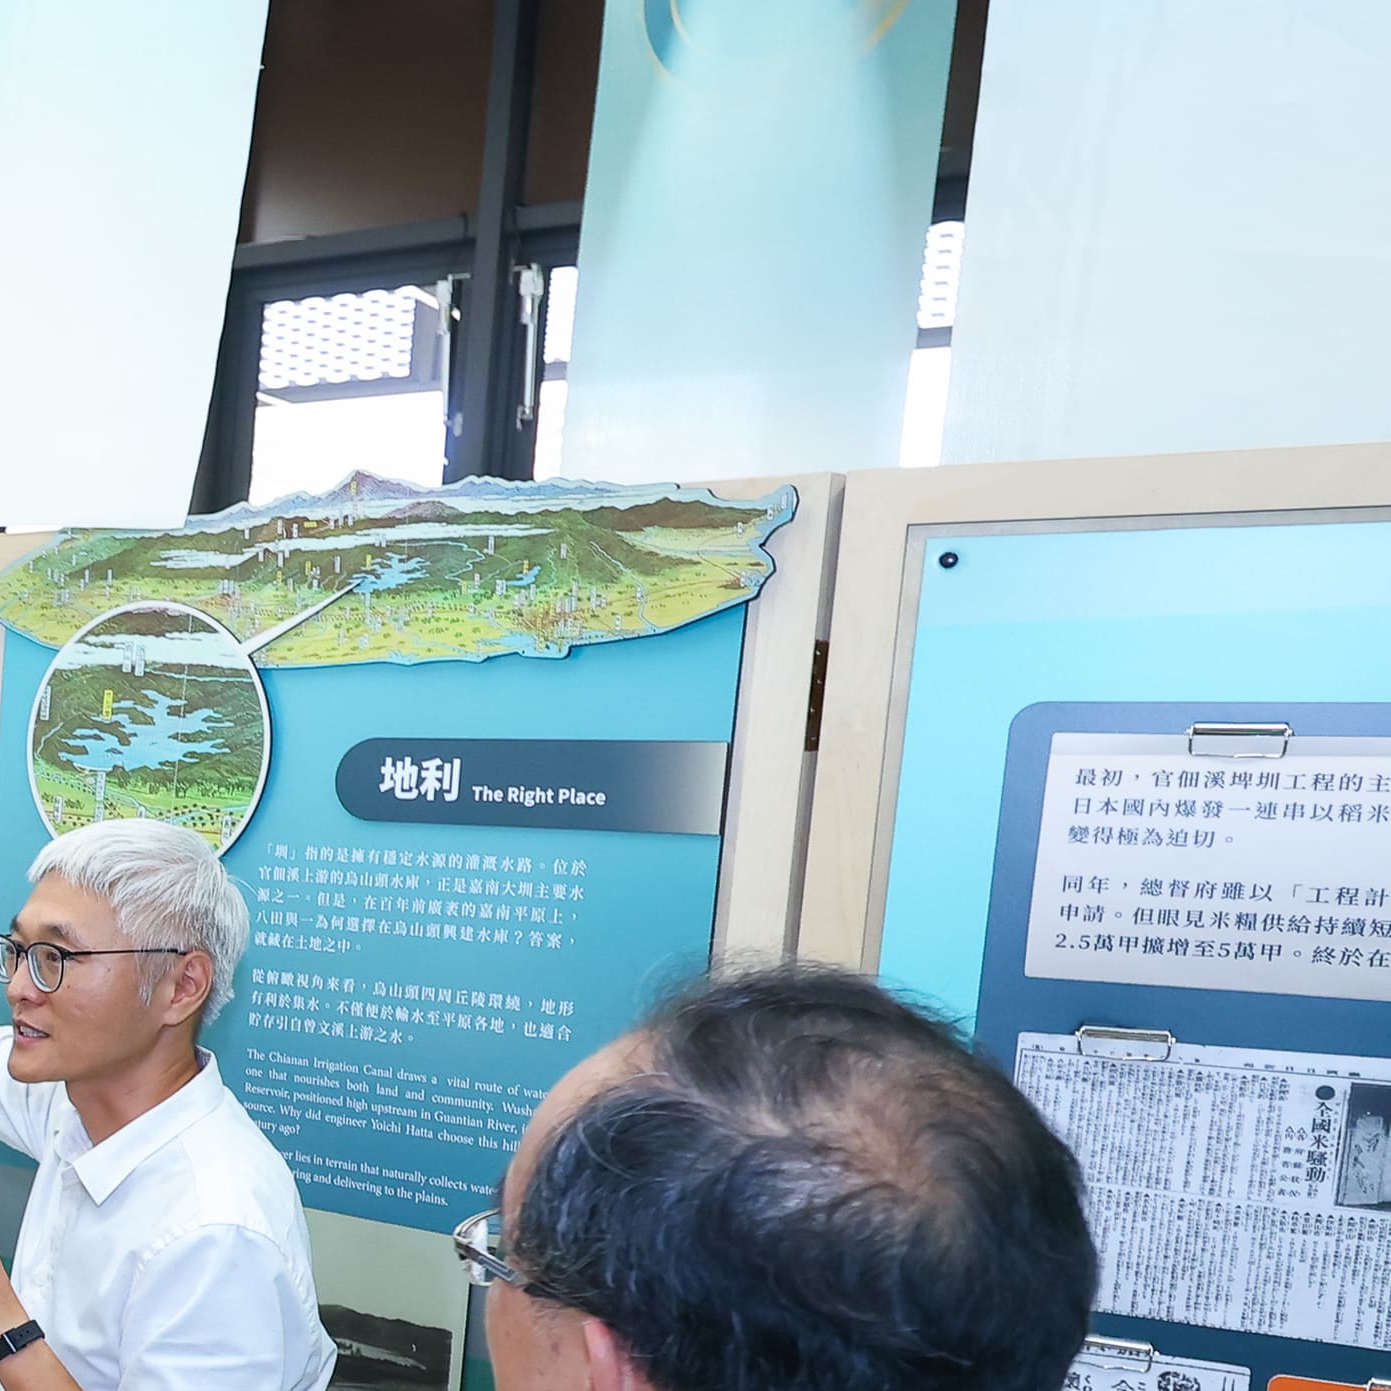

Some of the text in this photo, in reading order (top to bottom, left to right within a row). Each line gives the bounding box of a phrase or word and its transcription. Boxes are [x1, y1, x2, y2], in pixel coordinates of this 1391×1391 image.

[379, 756, 462, 803] 地利
[472, 785, 606, 807] The Right Place
[1074, 797, 1391, 823] 日本國內爆發一連串以稻米
[1068, 825, 1233, 848] 變得極為迫切。
[254, 930, 362, 954] 就藏在土地之中。
[246, 1067, 263, 1078] one
[269, 1069, 287, 1081] that
[294, 1072, 340, 1089] nourishes
[346, 1079, 369, 1093] both
[376, 1083, 398, 1097] land
[405, 1089, 425, 1102] and
[431, 1094, 494, 1114] community.
[247, 1049, 265, 1061] The
[269, 1051, 309, 1067] Chianan
[314, 1057, 358, 1074] Irrigation
[363, 1064, 392, 1079] Canal
[397, 1069, 427, 1083] draws
[431, 1076, 438, 1084] a
[447, 1077, 470, 1089] vital
[475, 1082, 503, 1095] route
[507, 1084, 520, 1096] of
[243, 1102, 276, 1114] source.
[279, 1104, 302, 1120] Why
[305, 1109, 321, 1121] did
[325, 1113, 367, 1129] engineer
[370, 1119, 401, 1134] Yoichi
[406, 1124, 433, 1139] Hatta
[437, 1129, 475, 1145] choose
[478, 1136, 498, 1149] this
[245, 1082, 290, 1099] Reservoir,
[293, 1090, 343, 1108] positioned
[346, 1096, 368, 1113] high
[371, 1103, 417, 1119] upstream
[421, 1108, 431, 1121] in
[434, 1111, 483, 1128] Guantian
[487, 1118, 518, 1134] River,
[279, 1123, 300, 1136] ago?
[295, 1151, 311, 1163] lies
[313, 1154, 323, 1165] in
[325, 1157, 358, 1172] terrain
[360, 1162, 379, 1175] that
[382, 1167, 427, 1186] naturally
[429, 1176, 467, 1191] collects
[313, 1172, 331, 1185] and
[333, 1177, 382, 1197] delivering
[384, 1185, 394, 1195] to
[397, 1187, 413, 1199] the
[415, 1191, 448, 1207] plains.
